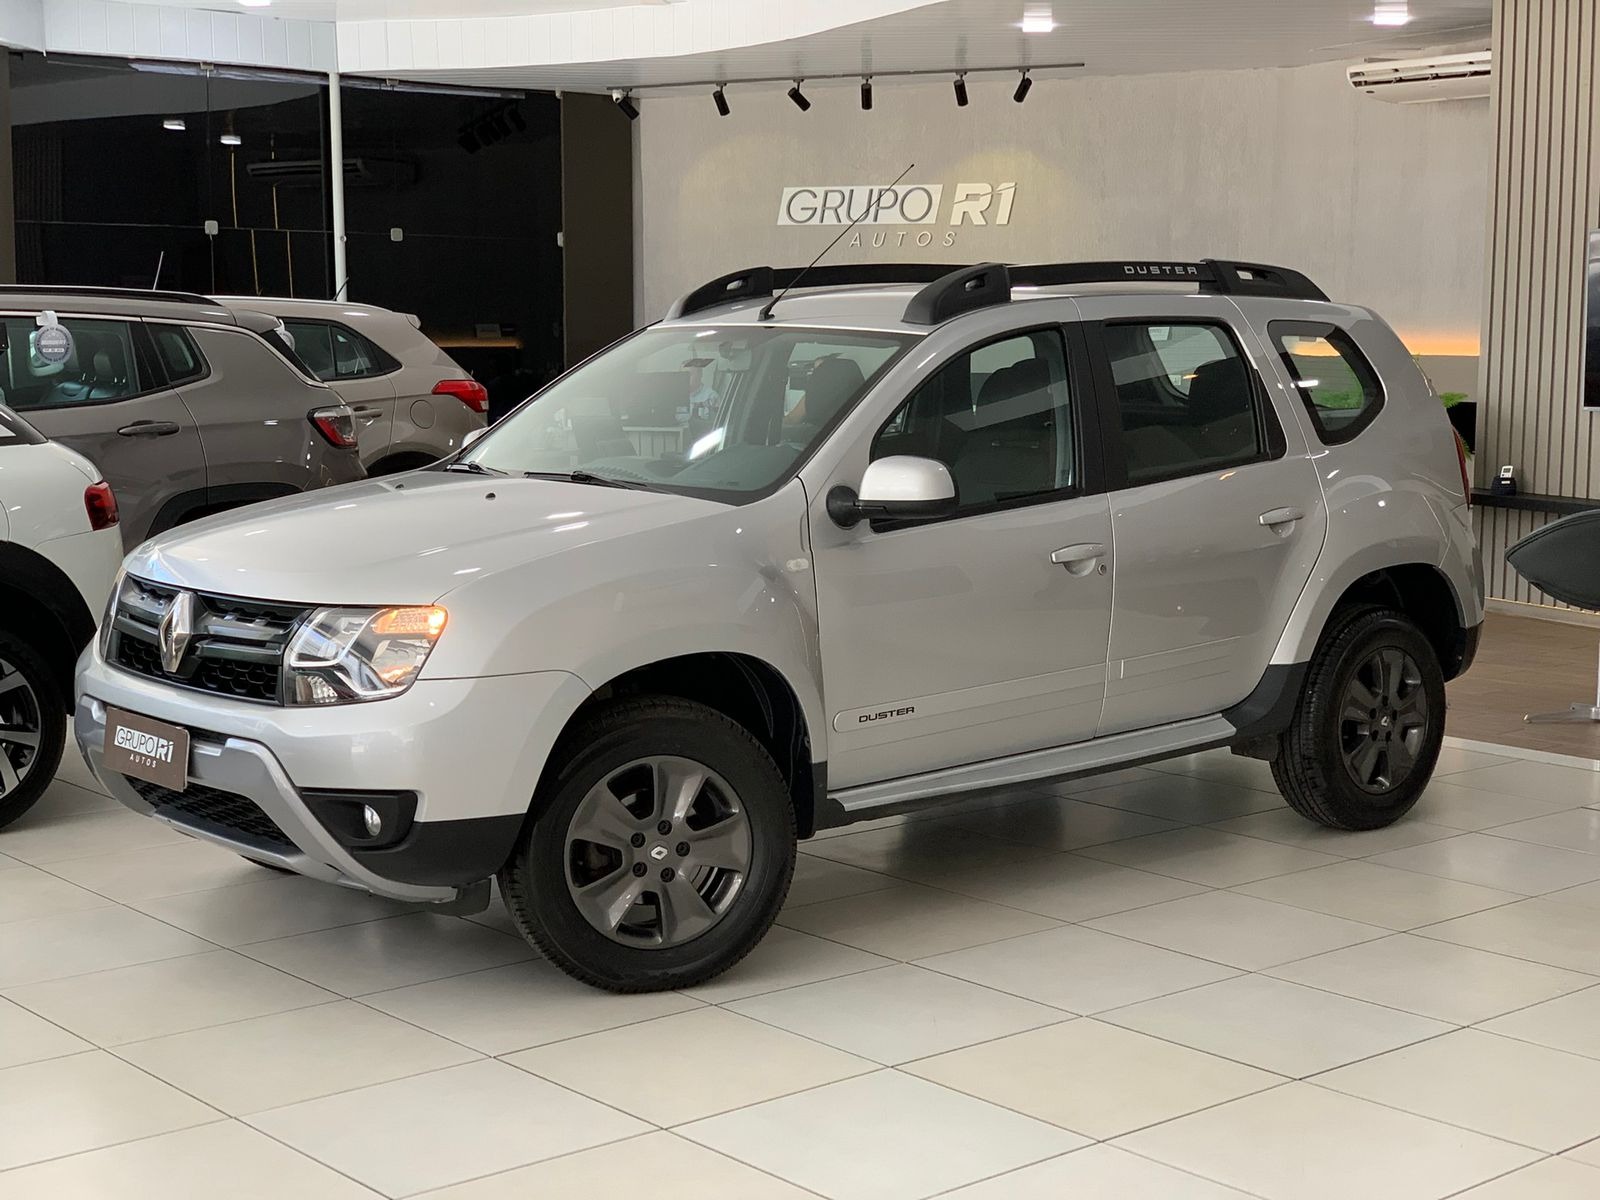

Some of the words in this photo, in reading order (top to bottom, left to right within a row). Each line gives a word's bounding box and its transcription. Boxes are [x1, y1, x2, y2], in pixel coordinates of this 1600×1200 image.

[785, 186, 933, 224] GRUPO
[950, 182, 1017, 226] R1
[849, 231, 957, 248] AUTOS
[1123, 265, 1198, 275] DUSTER
[858, 706, 916, 723] DUSTER
[116, 727, 156, 754] GRUPO
[156, 737, 175, 763] R1
[129, 753, 157, 768] AUTOS
